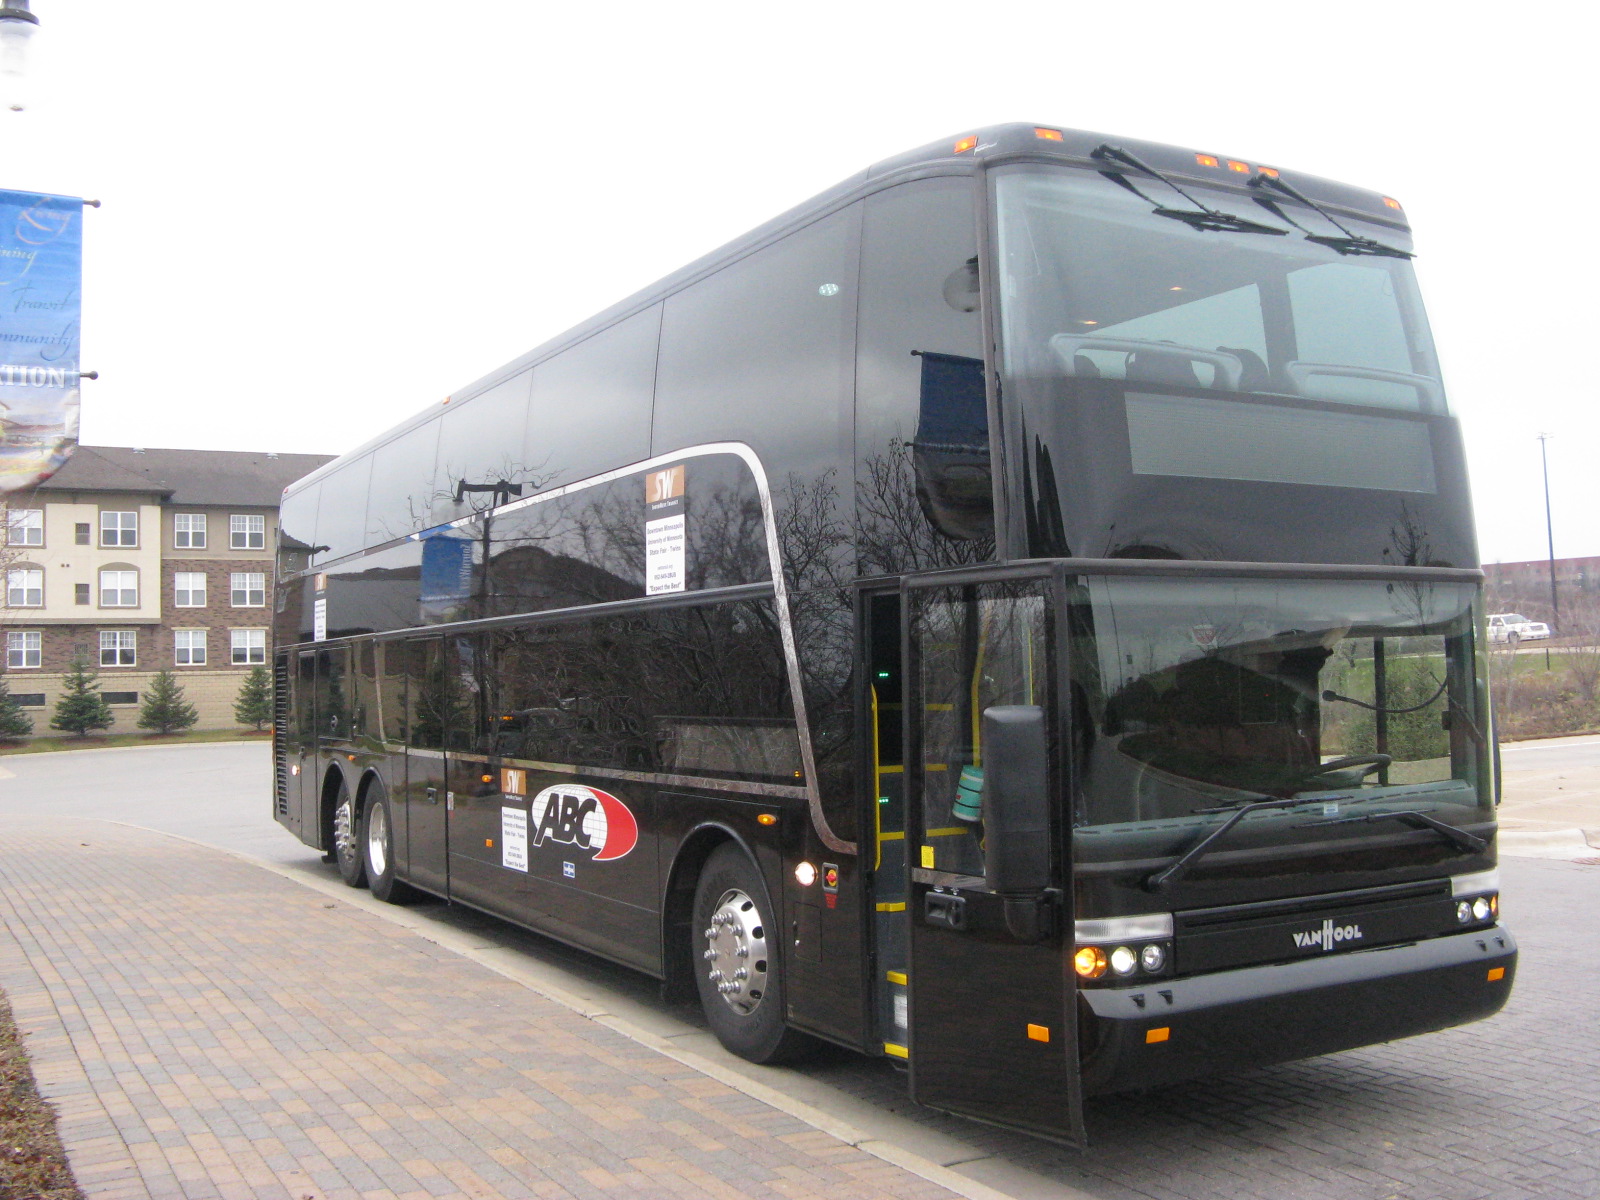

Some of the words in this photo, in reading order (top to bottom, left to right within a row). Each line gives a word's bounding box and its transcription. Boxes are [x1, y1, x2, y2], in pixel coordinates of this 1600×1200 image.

[11, 279, 76, 314] Transit
[0, 365, 66, 389] TION
[653, 469, 679, 501] SW
[533, 792, 598, 849] ABC
